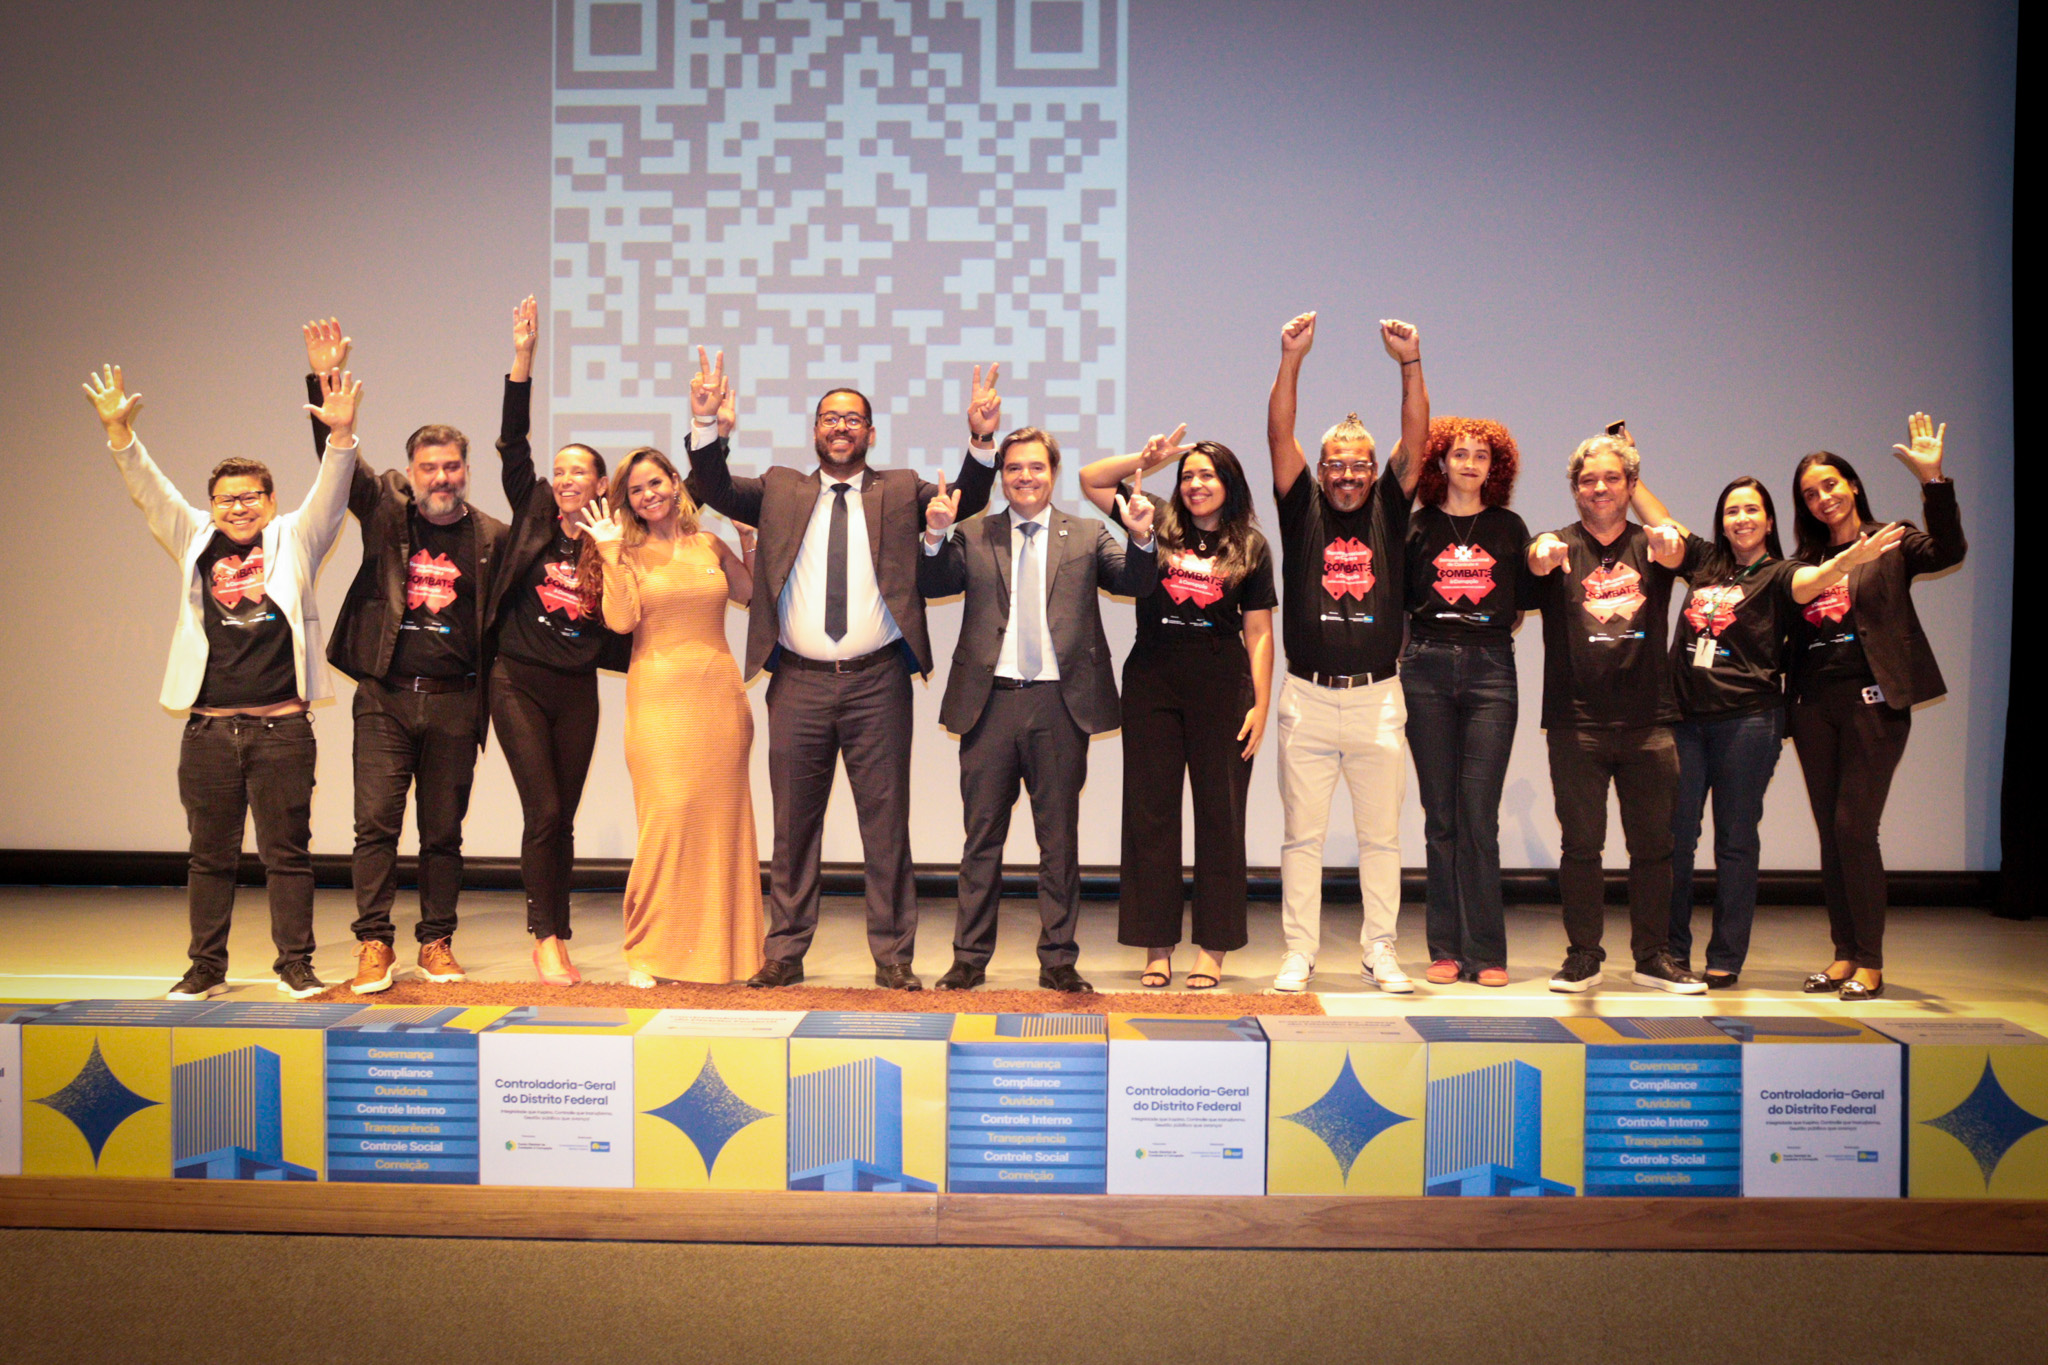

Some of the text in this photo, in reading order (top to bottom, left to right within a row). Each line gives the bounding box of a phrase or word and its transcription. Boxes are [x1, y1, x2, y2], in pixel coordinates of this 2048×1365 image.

[368, 1049, 434, 1061] Governança
[993, 1058, 1060, 1069] Governança
[1630, 1061, 1697, 1072] Governança
[369, 1067, 433, 1078] Compliance
[495, 1079, 615, 1090] Controladoria-Geral
[993, 1077, 1060, 1088] Compliance
[1630, 1080, 1696, 1091] Compliance
[376, 1086, 427, 1096] Ouvidoria
[1126, 1086, 1249, 1096] Controladoria-Geral
[1761, 1089, 1884, 1099] Controladoria-Geral
[503, 1094, 608, 1105] do Distrito Federal
[1000, 1096, 1053, 1105] Ouvidoria
[1637, 1099, 1690, 1107] Ouvidoria
[358, 1104, 445, 1114] Controle Interno
[1134, 1101, 1241, 1111] do Distrito Federal
[1768, 1104, 1876, 1114] do Distrito Federal
[981, 1114, 1072, 1124] Controle Interno
[1618, 1117, 1708, 1126] Controle Interno
[364, 1123, 440, 1133] Transparência
[988, 1133, 1065, 1144] Transparência
[1624, 1136, 1702, 1147] Transparência
[361, 1141, 442, 1151] Controle Social
[984, 1152, 1068, 1161] Controle Social
[1620, 1155, 1705, 1164] Controle Social
[376, 1160, 429, 1171] Correição
[999, 1171, 1054, 1181] Correição
[1635, 1173, 1690, 1183] Correição
